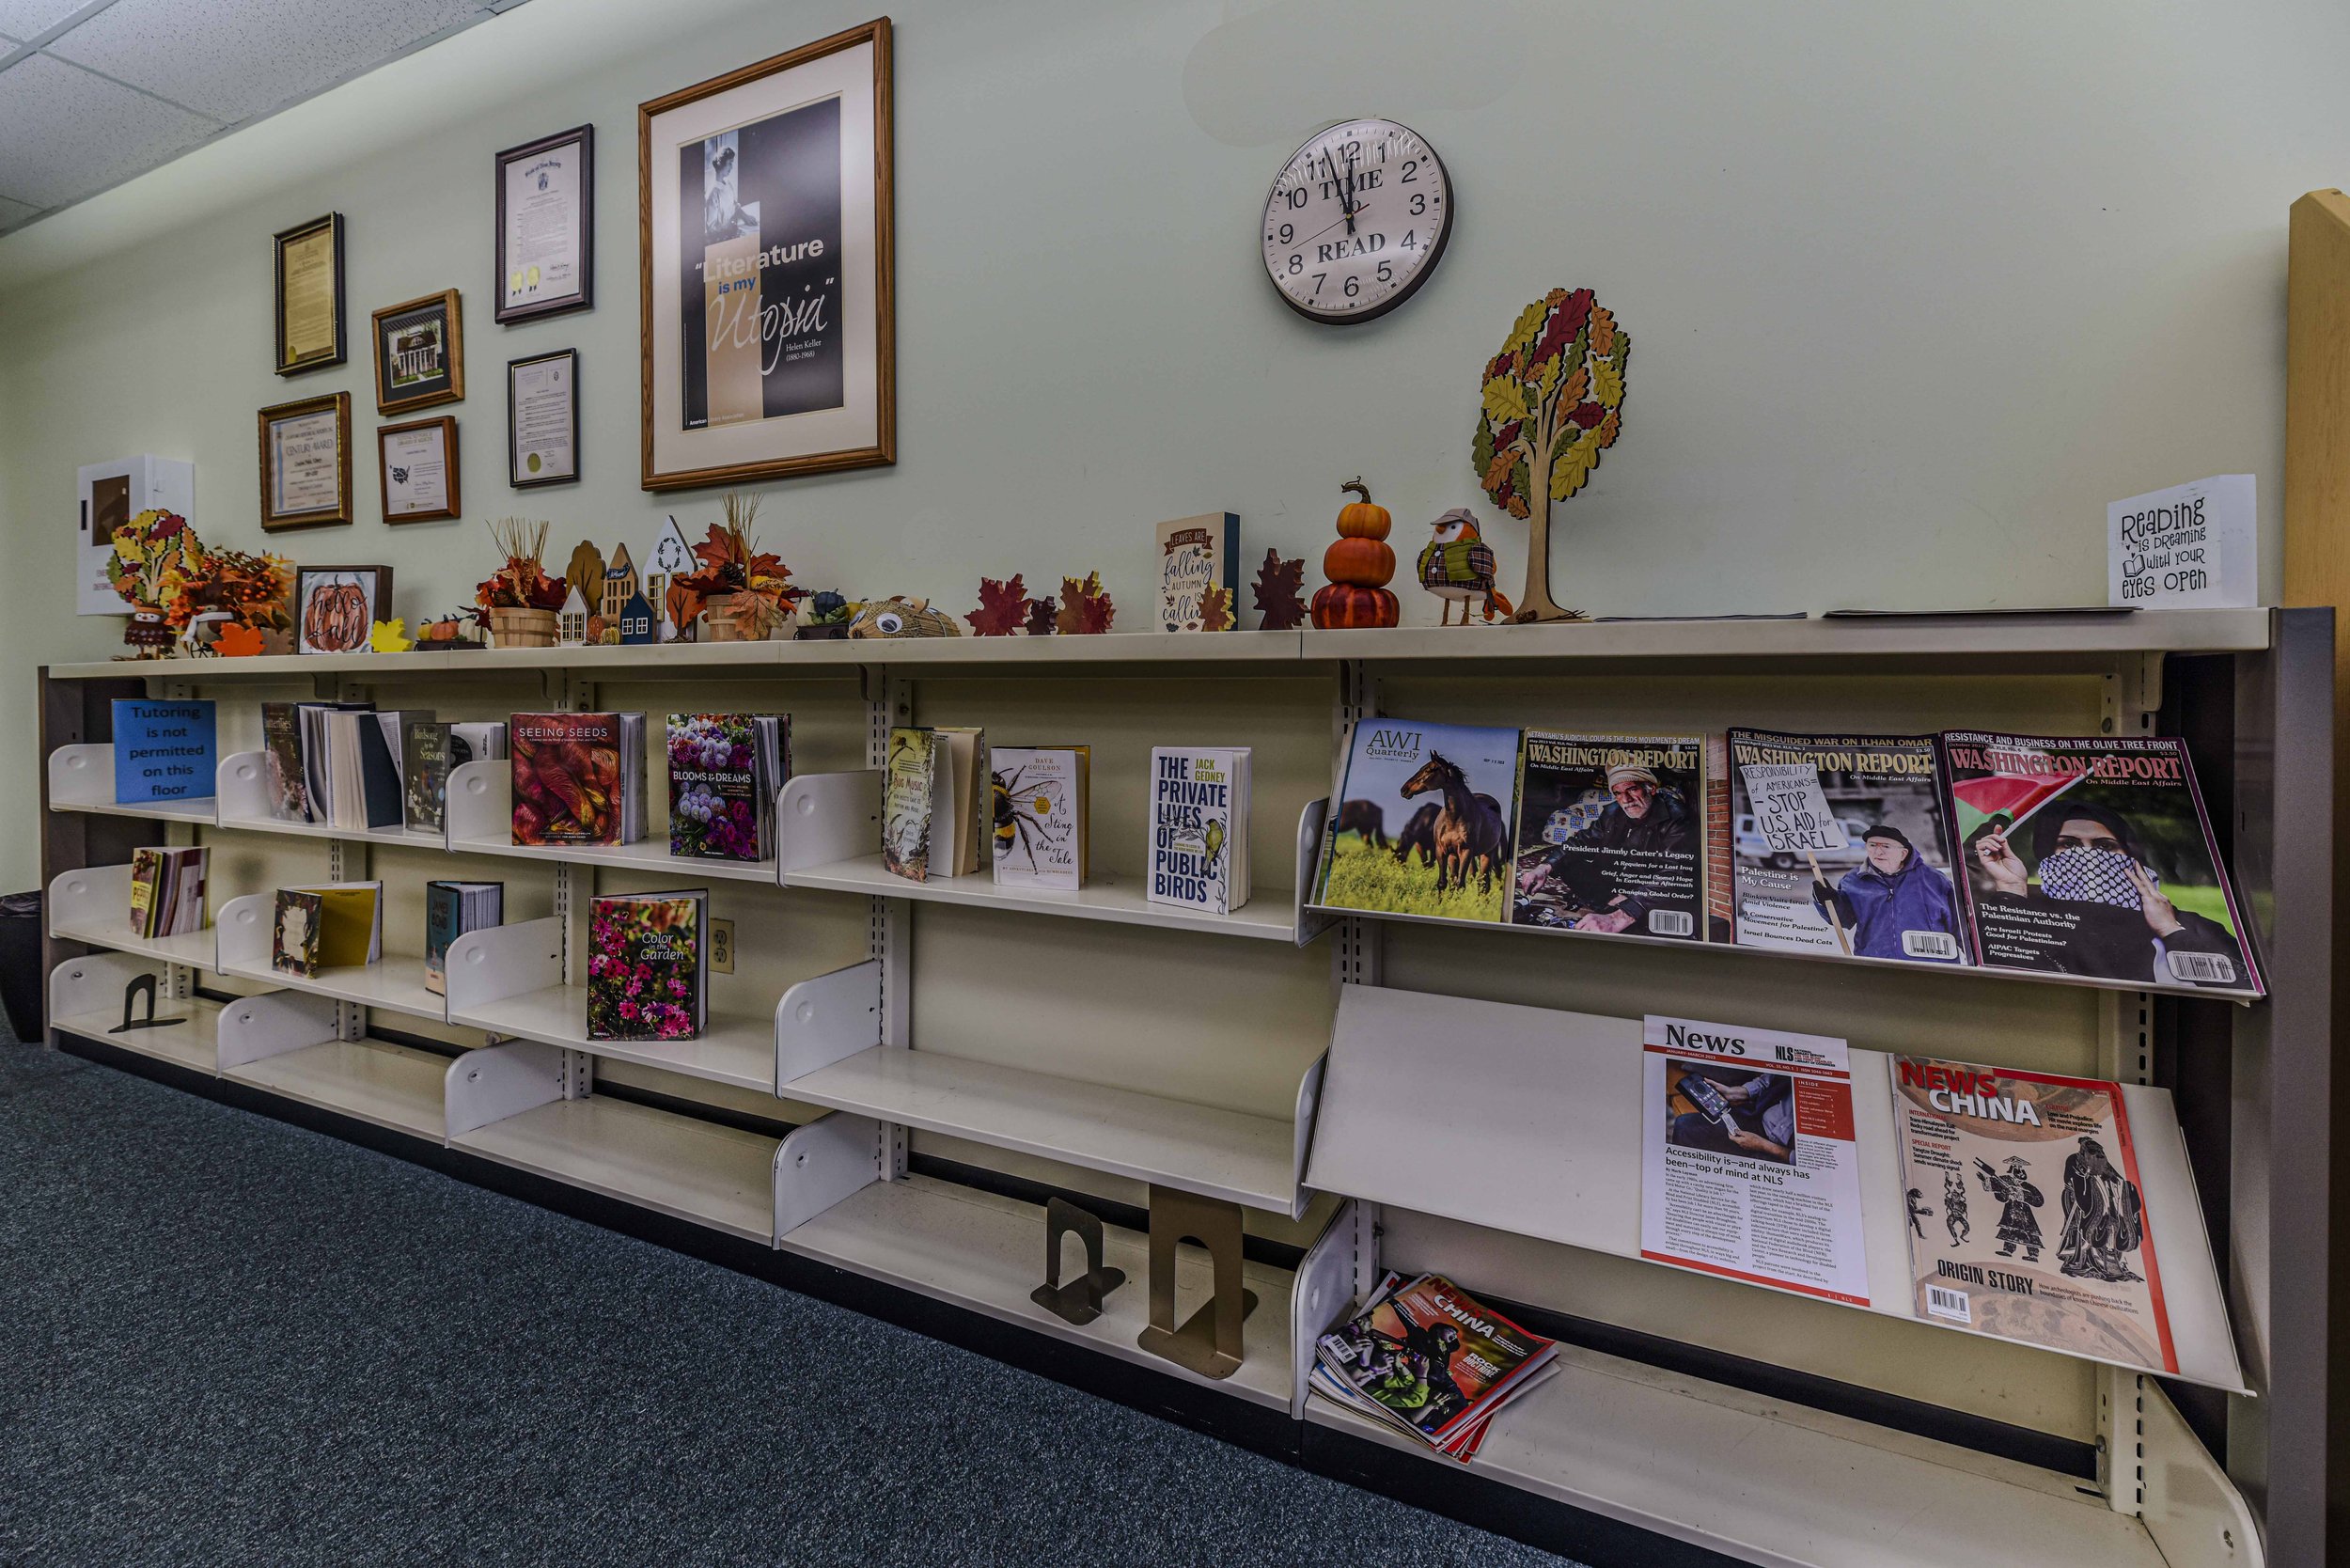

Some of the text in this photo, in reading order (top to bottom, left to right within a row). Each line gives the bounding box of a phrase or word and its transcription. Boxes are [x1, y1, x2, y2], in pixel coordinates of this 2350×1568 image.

[1338, 140, 1361, 163] 12
[1378, 142, 1386, 164] 1
[1307, 158, 1325, 180] 11
[1401, 160, 1418, 183] 2
[1319, 168, 1384, 201] TIME
[1285, 187, 1308, 211] 10
[1339, 199, 1362, 214] TO
[1410, 194, 1426, 216] 3
[1279, 224, 1293, 244] 9
[1401, 229, 1417, 251] 4
[1317, 233, 1386, 264] READ
[1288, 254, 1304, 274] 8
[1377, 259, 1392, 282] 5
[718, 276, 757, 294] is my
[1312, 273, 1327, 294] 7
[1343, 276, 1359, 297] 6
[786, 339, 822, 353] Helen Keller
[786, 351, 815, 362] (1880-1968)
[689, 417, 707, 426] American
[286, 438, 334, 456] CENTURY AWARD
[1171, 531, 1206, 545] LEAVES ARE
[1164, 551, 1216, 586] falling
[1171, 580, 1202, 591] AUTUMN
[306, 588, 368, 616] hello
[1194, 592, 1202, 602] IS
[306, 615, 368, 651] fall
[132, 706, 201, 720] Tutoring
[147, 727, 188, 738] is not
[415, 729, 438, 743] Birdsong
[519, 728, 608, 737] SEEING SEEDS
[1367, 729, 1422, 751] AWI
[1564, 733, 1590, 742] JUDICIAL
[1638, 736, 1678, 745] MOVEMENT'S
[1731, 730, 1752, 740] THE
[1754, 733, 1811, 745] MISGUIDED
[1861, 738, 1894, 746] ILHAN
[1897, 738, 1933, 746] OMAR
[1944, 733, 2178, 750] RESISTANCE AND BUSINESS ON THE OLIVE TREE FRONT
[129, 745, 205, 761] permitted
[419, 747, 446, 761] Seasons
[1366, 746, 1419, 760] Quarterly
[1528, 744, 1698, 770] WASHINGTON REPORT
[1733, 745, 1933, 775] WASHINGTON REPORT
[143, 765, 194, 777] on this
[1159, 756, 1189, 780] THE
[1195, 758, 1214, 770] JACK
[1743, 765, 1812, 779] RESPONSIBILITY
[1950, 748, 2181, 779] WASHINGTON REPORT
[673, 771, 751, 784] BLOOMS & DREAMS
[1195, 770, 1226, 783] GEDNEY
[151, 785, 188, 796] floor
[1158, 779, 1227, 808] PRIVATE
[1751, 782, 1759, 794] of
[1055, 793, 1066, 815] A
[1768, 791, 1807, 814] STOP
[1044, 813, 1073, 836] Sting
[1157, 803, 1201, 829] LIVES
[1760, 812, 1833, 834] U.S. AID for
[1056, 834, 1068, 842] in
[1156, 826, 1177, 850] OF
[1766, 830, 1838, 851] ISRAEL
[1035, 840, 1073, 865] the Tale
[1562, 844, 1694, 860] President Jimmy Carter's Legacy
[1156, 849, 1218, 881] PUBLIC
[1741, 866, 1799, 881] Palestine is
[1154, 872, 1207, 903] BIRDS
[1742, 876, 1793, 890] My Cause
[1979, 902, 1998, 912] The
[1999, 905, 2047, 917] Resistance
[2064, 913, 2081, 921] the
[1982, 911, 2076, 930] Palestinian Authority
[642, 932, 674, 945] Color
[1744, 929, 1762, 937] Israel
[1764, 933, 1794, 941] Bounces
[640, 949, 684, 961] Garden
[1665, 1024, 1746, 1056] News
[1775, 1044, 1794, 1062] NLS
[1900, 1060, 1998, 1099] NEWS
[1929, 1089, 2042, 1127] CHINA
[1911, 1138, 1951, 1152] SPECIAL REPORT
[1666, 1146, 1722, 1166] Accessibility
[1758, 1160, 1791, 1177] always
[1793, 1166, 1810, 1180] has
[1713, 1164, 1724, 1175] of
[1725, 1167, 1748, 1180] mind
[1750, 1172, 1762, 1182] at
[1762, 1173, 1784, 1185] NLS
[1937, 1259, 2033, 1295] ORIGIN STORY
[1428, 1277, 1482, 1319] NEWS
[1433, 1294, 1495, 1339] CHINA
[1463, 1356, 1497, 1378] DOCTRINE
[1467, 1352, 1501, 1372] ROCK
